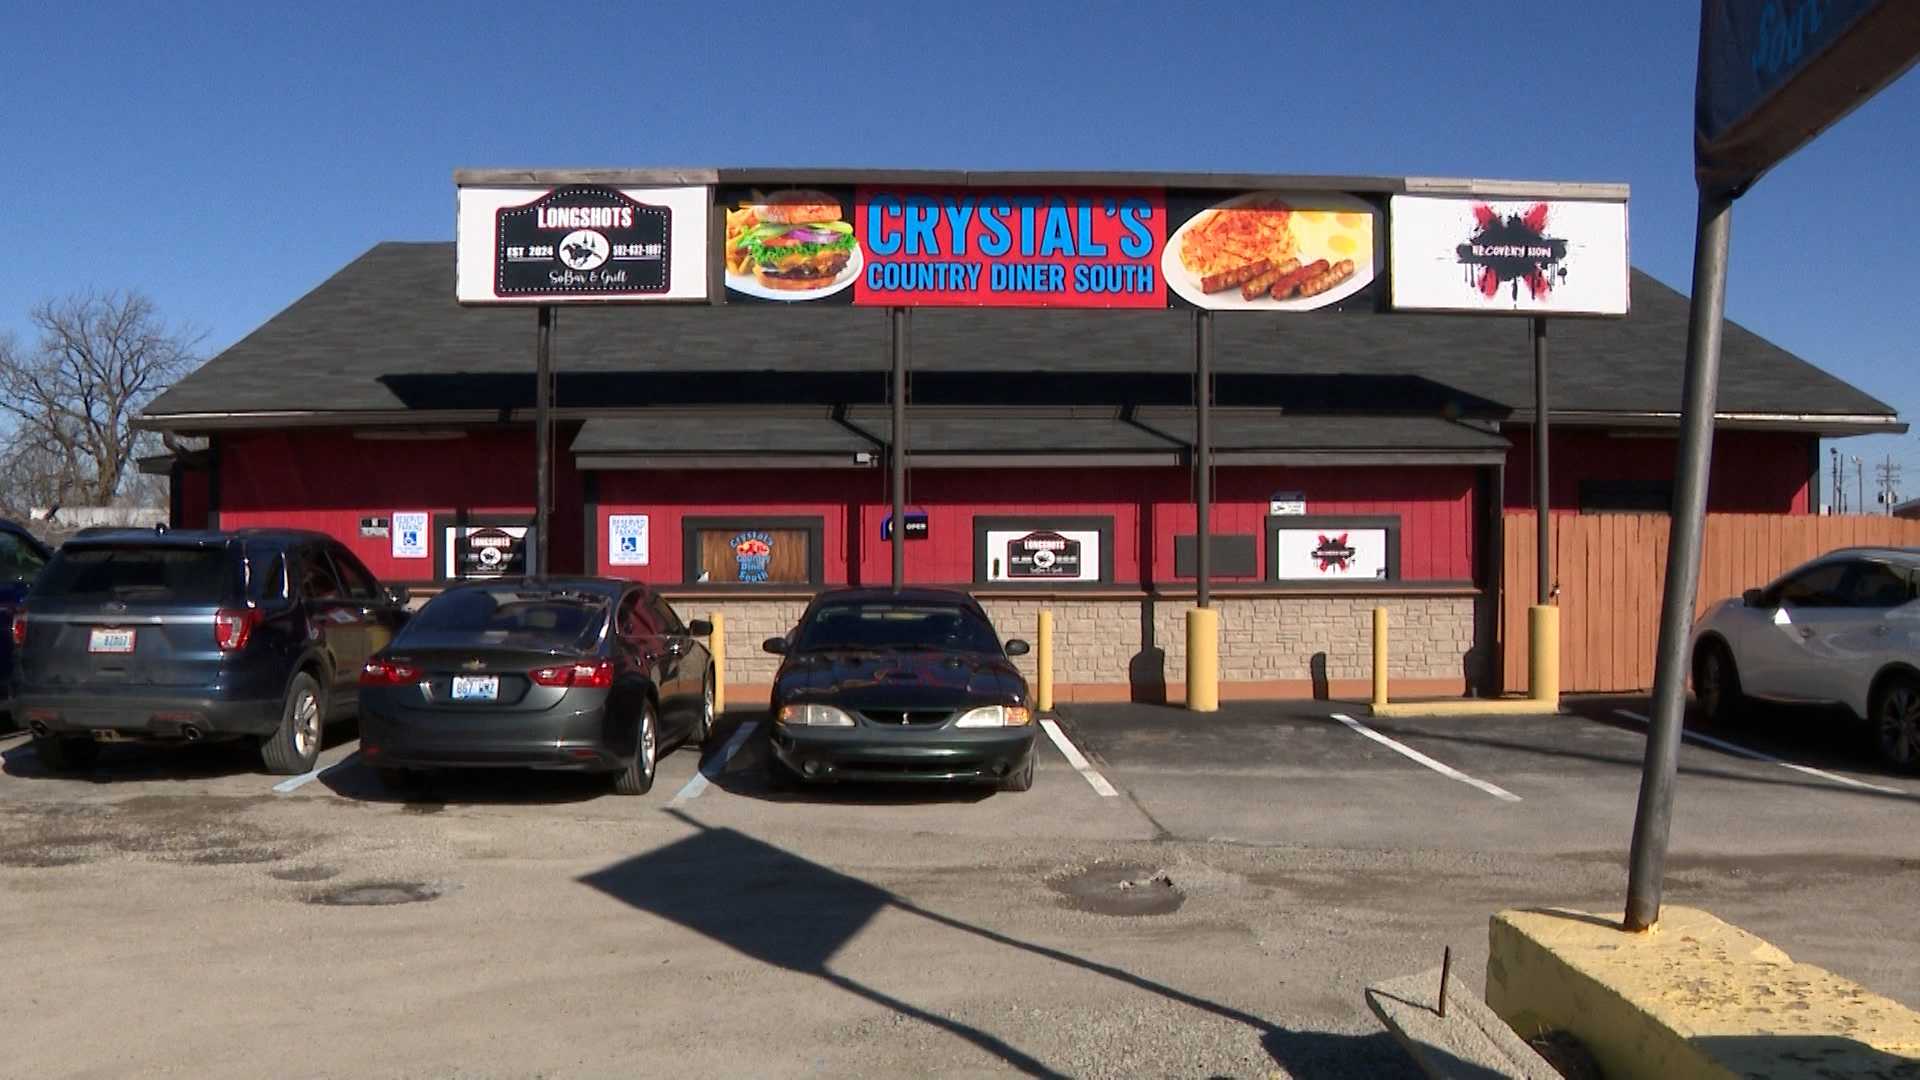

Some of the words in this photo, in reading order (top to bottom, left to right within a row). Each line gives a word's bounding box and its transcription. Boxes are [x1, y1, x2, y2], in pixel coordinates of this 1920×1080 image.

[537, 206, 632, 228] LONGSHOTS
[866, 195, 1154, 258] CRYSTAL'S
[507, 247, 524, 257] EST
[600, 270, 628, 285] Grill
[867, 262, 981, 291] COUNTRY
[990, 264, 1065, 292] DINER
[1074, 265, 1154, 293] SOUTH
